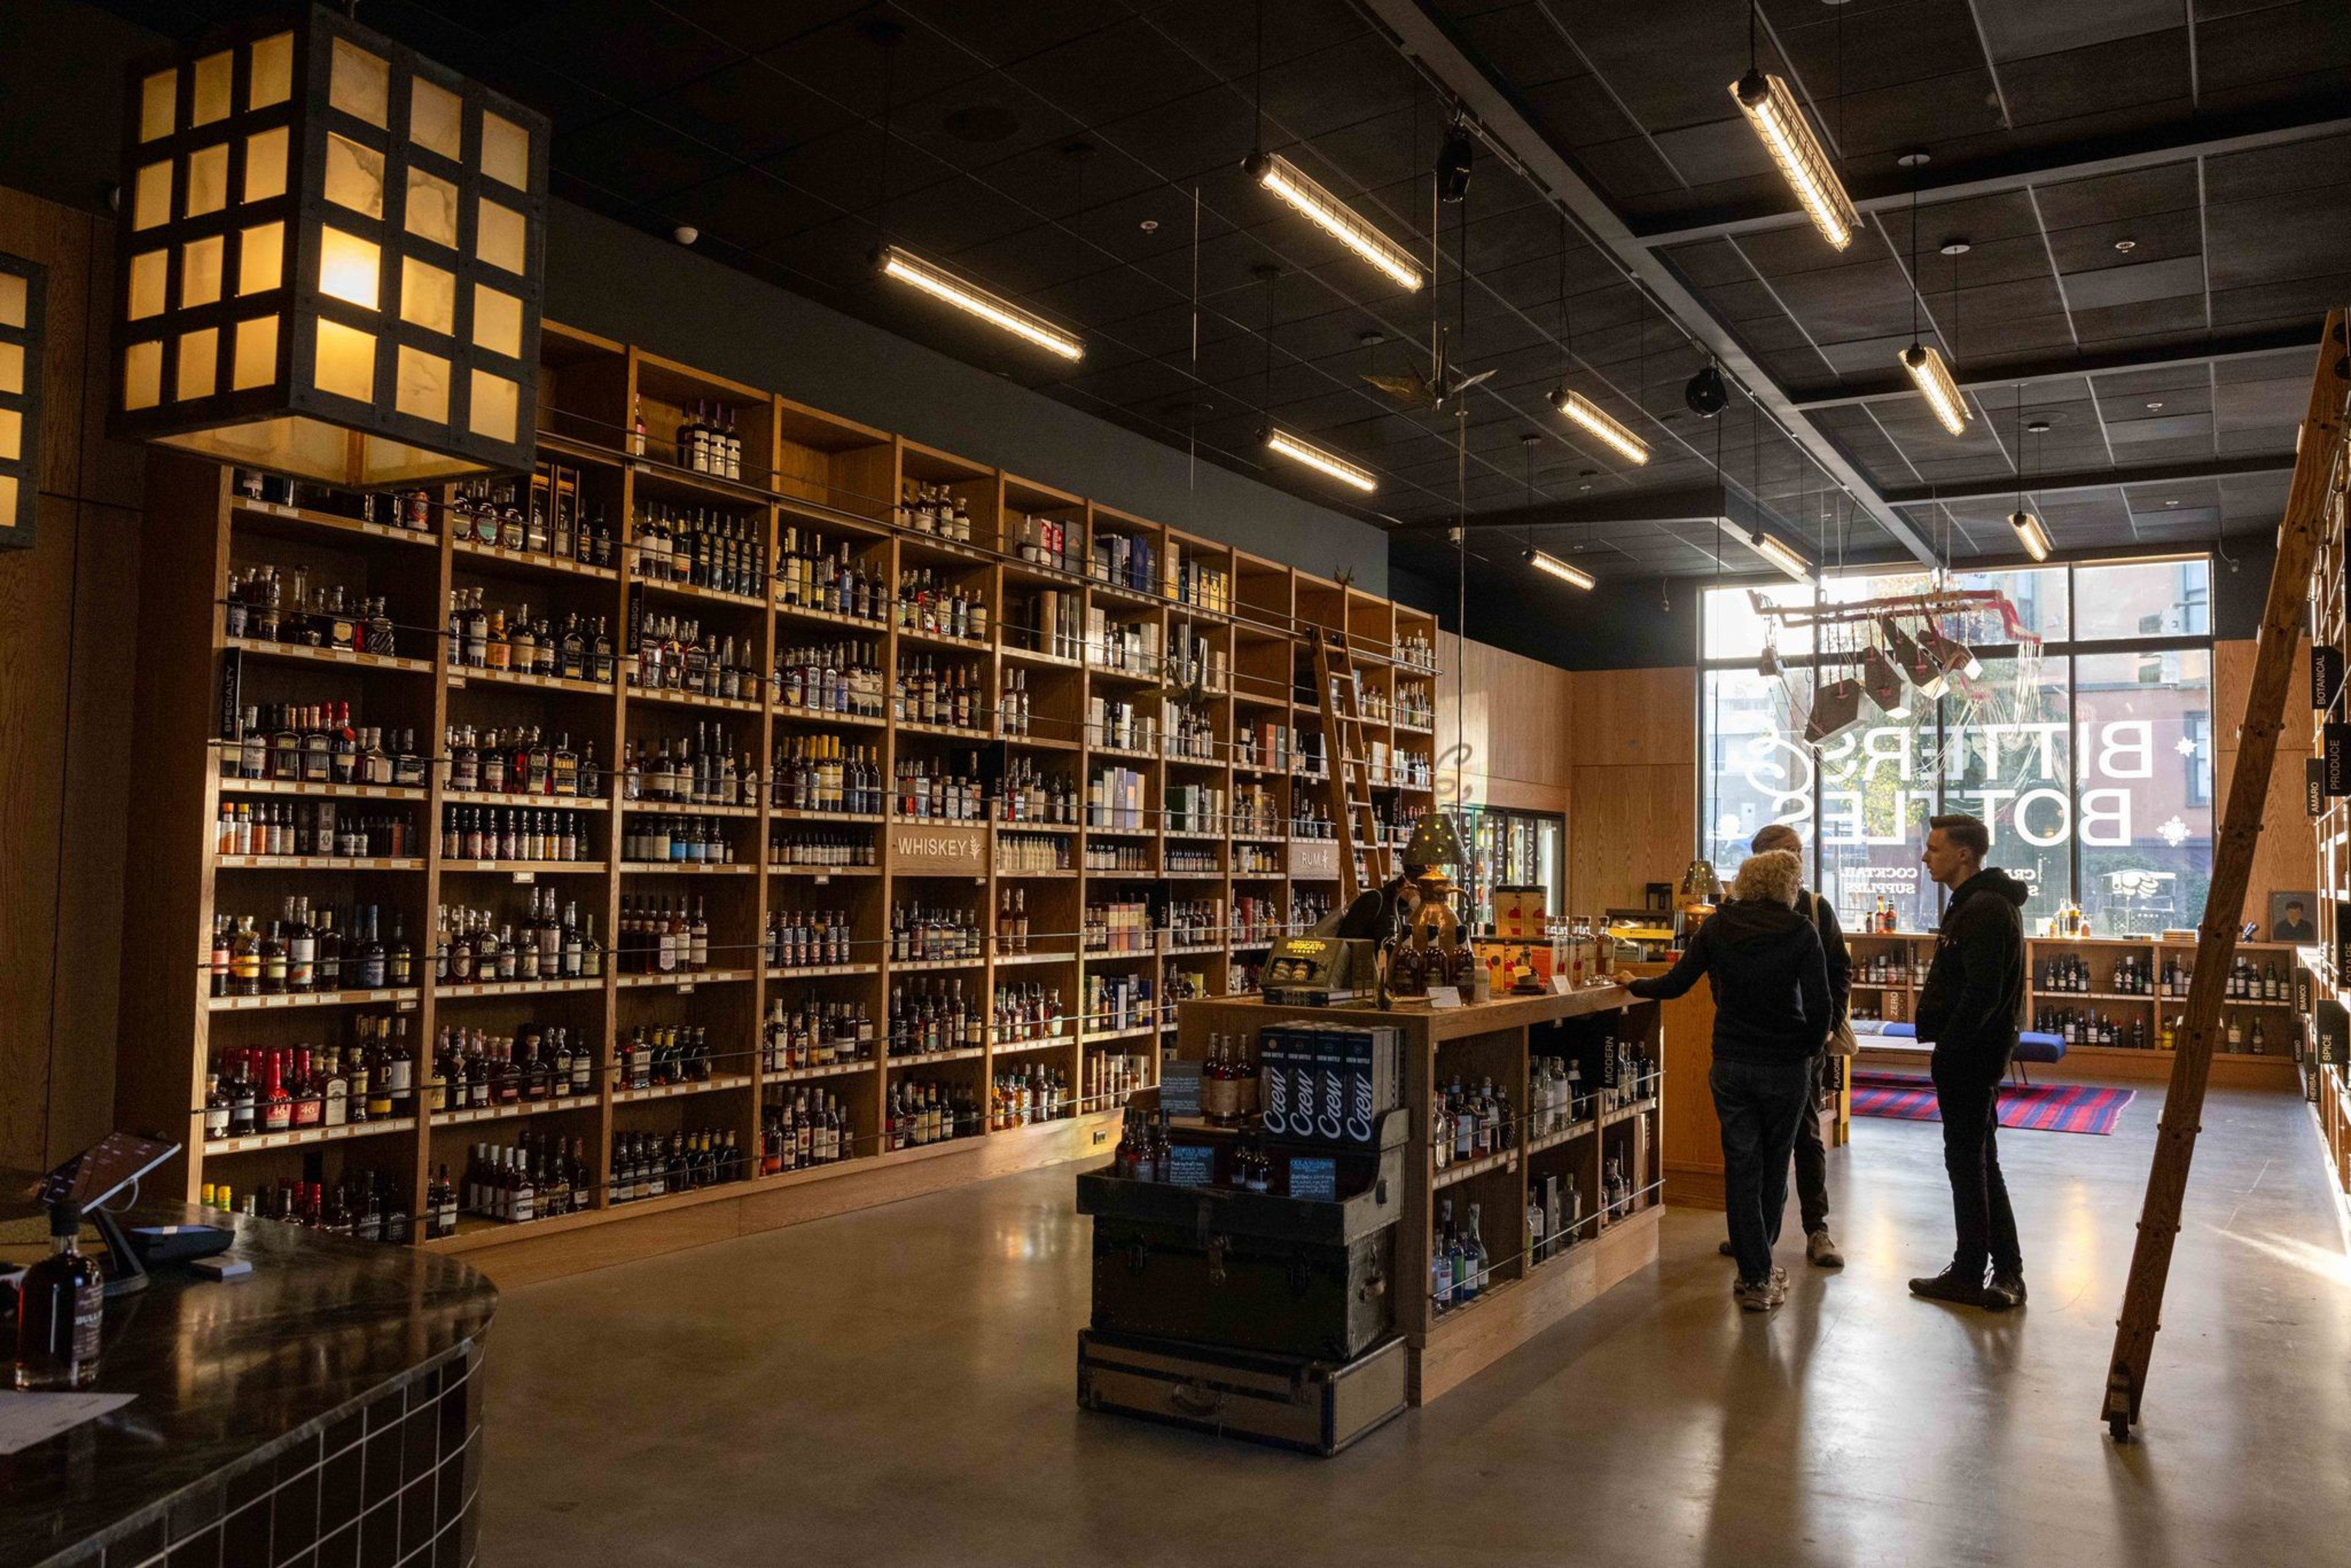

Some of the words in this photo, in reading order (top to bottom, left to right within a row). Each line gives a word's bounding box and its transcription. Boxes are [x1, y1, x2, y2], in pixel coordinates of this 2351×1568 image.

[630, 598, 640, 650] BOURBON
[224, 664, 235, 732] SPECIALTY
[2317, 655, 2326, 705] BOTANICAL
[2330, 739, 2340, 790] PRODUCE
[2310, 781, 2320, 813] AMARO
[898, 837, 967, 856] WHISKEY
[1302, 852, 1321, 866] RUM
[1604, 1036, 1614, 1084] MODERN
[2322, 1034, 2332, 1060] SPICE
[1263, 1065, 1286, 1134] Crew
[1289, 1067, 1314, 1136] Crew
[1318, 1070, 1343, 1139] Crew
[1346, 1072, 1372, 1142] Crew
